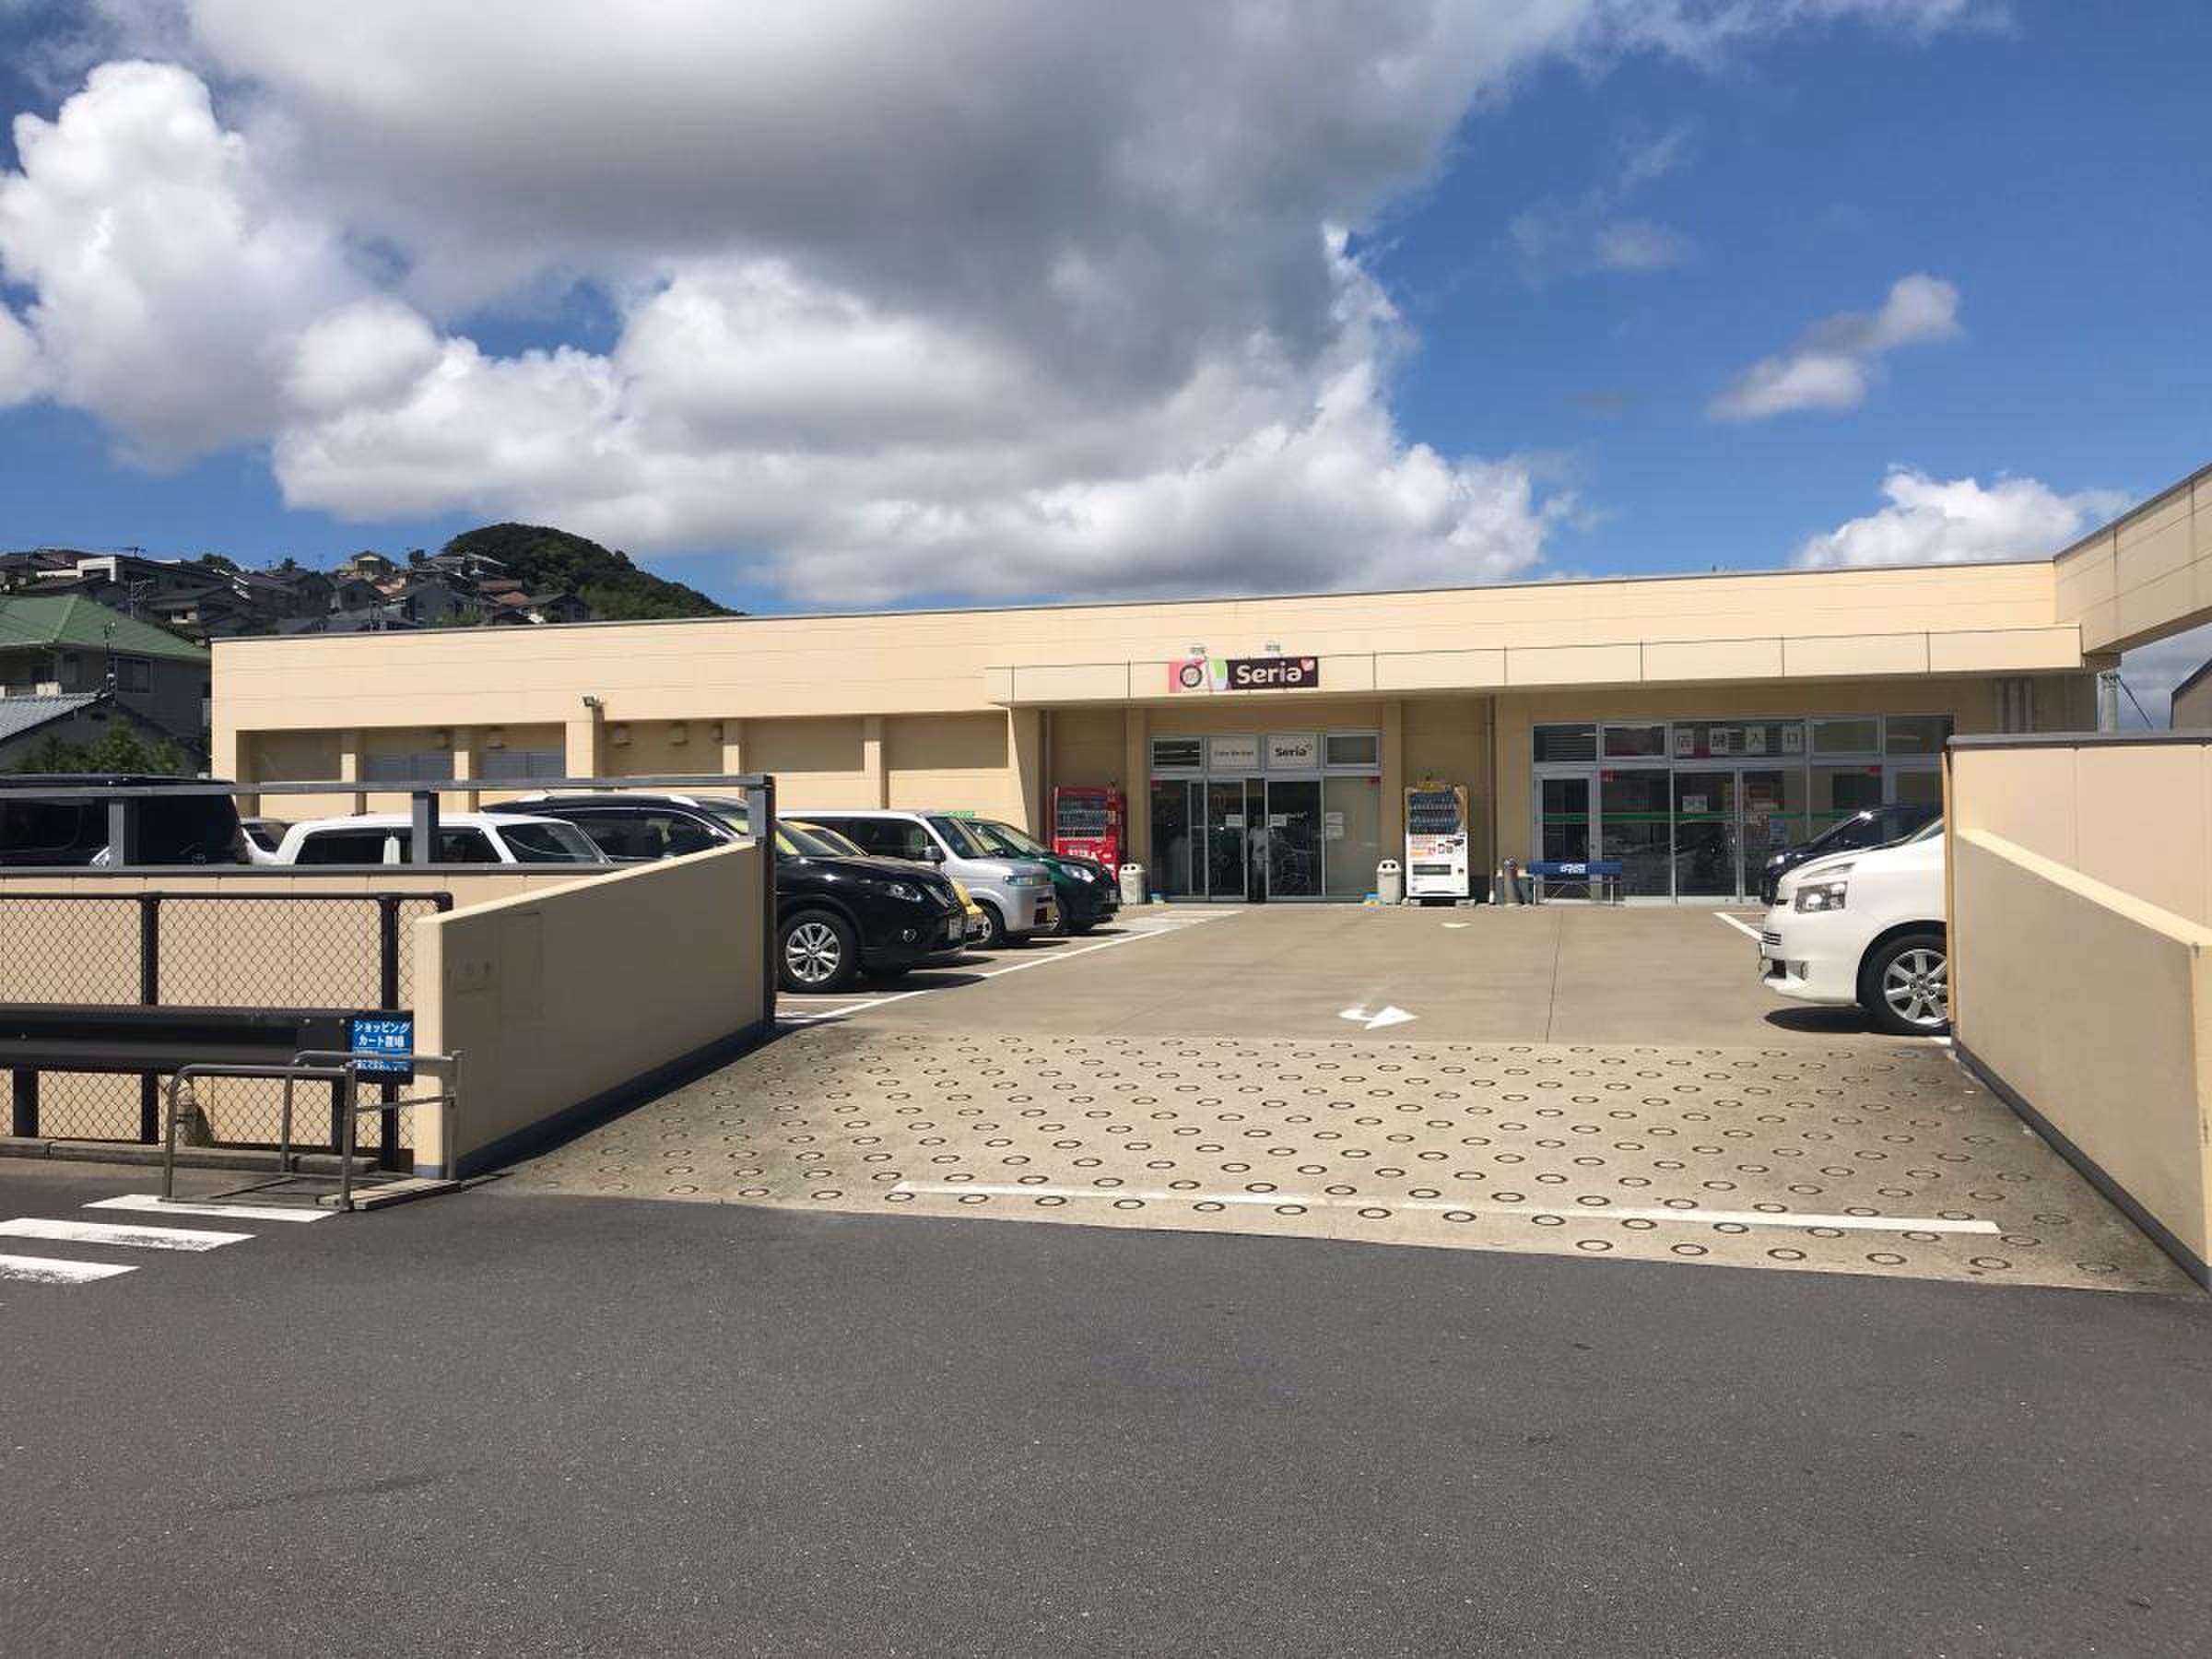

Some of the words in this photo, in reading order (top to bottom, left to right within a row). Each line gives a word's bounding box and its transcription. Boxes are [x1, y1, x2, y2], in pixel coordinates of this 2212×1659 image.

[1236, 661, 1302, 685] Seria
[1275, 746, 1307, 757] Seria
[354, 1020, 412, 1033] ショッピング
